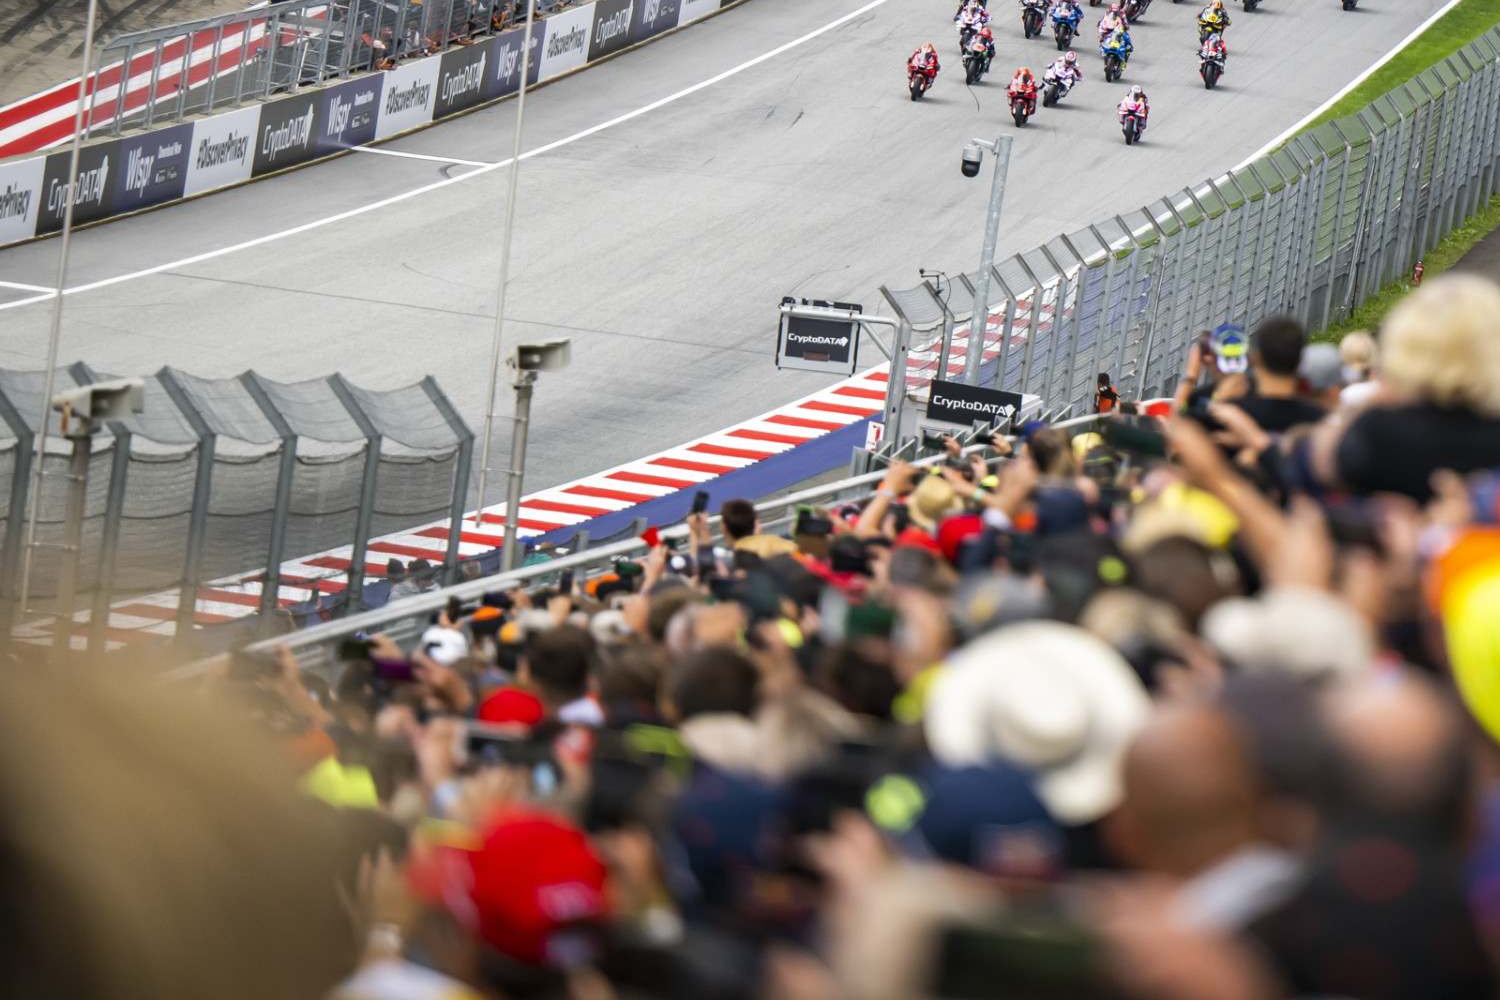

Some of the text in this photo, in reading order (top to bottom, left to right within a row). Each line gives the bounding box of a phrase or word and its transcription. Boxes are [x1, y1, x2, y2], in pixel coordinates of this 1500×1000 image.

[262, 113, 306, 161] CryptoDATA
[327, 94, 352, 142] Wispr
[126, 146, 155, 198] Wispr
[196, 130, 249, 170] #DiscoverPrivacy
[788, 333, 841, 346] CryptoDATA
[933, 395, 1007, 416] CryptoDATA
